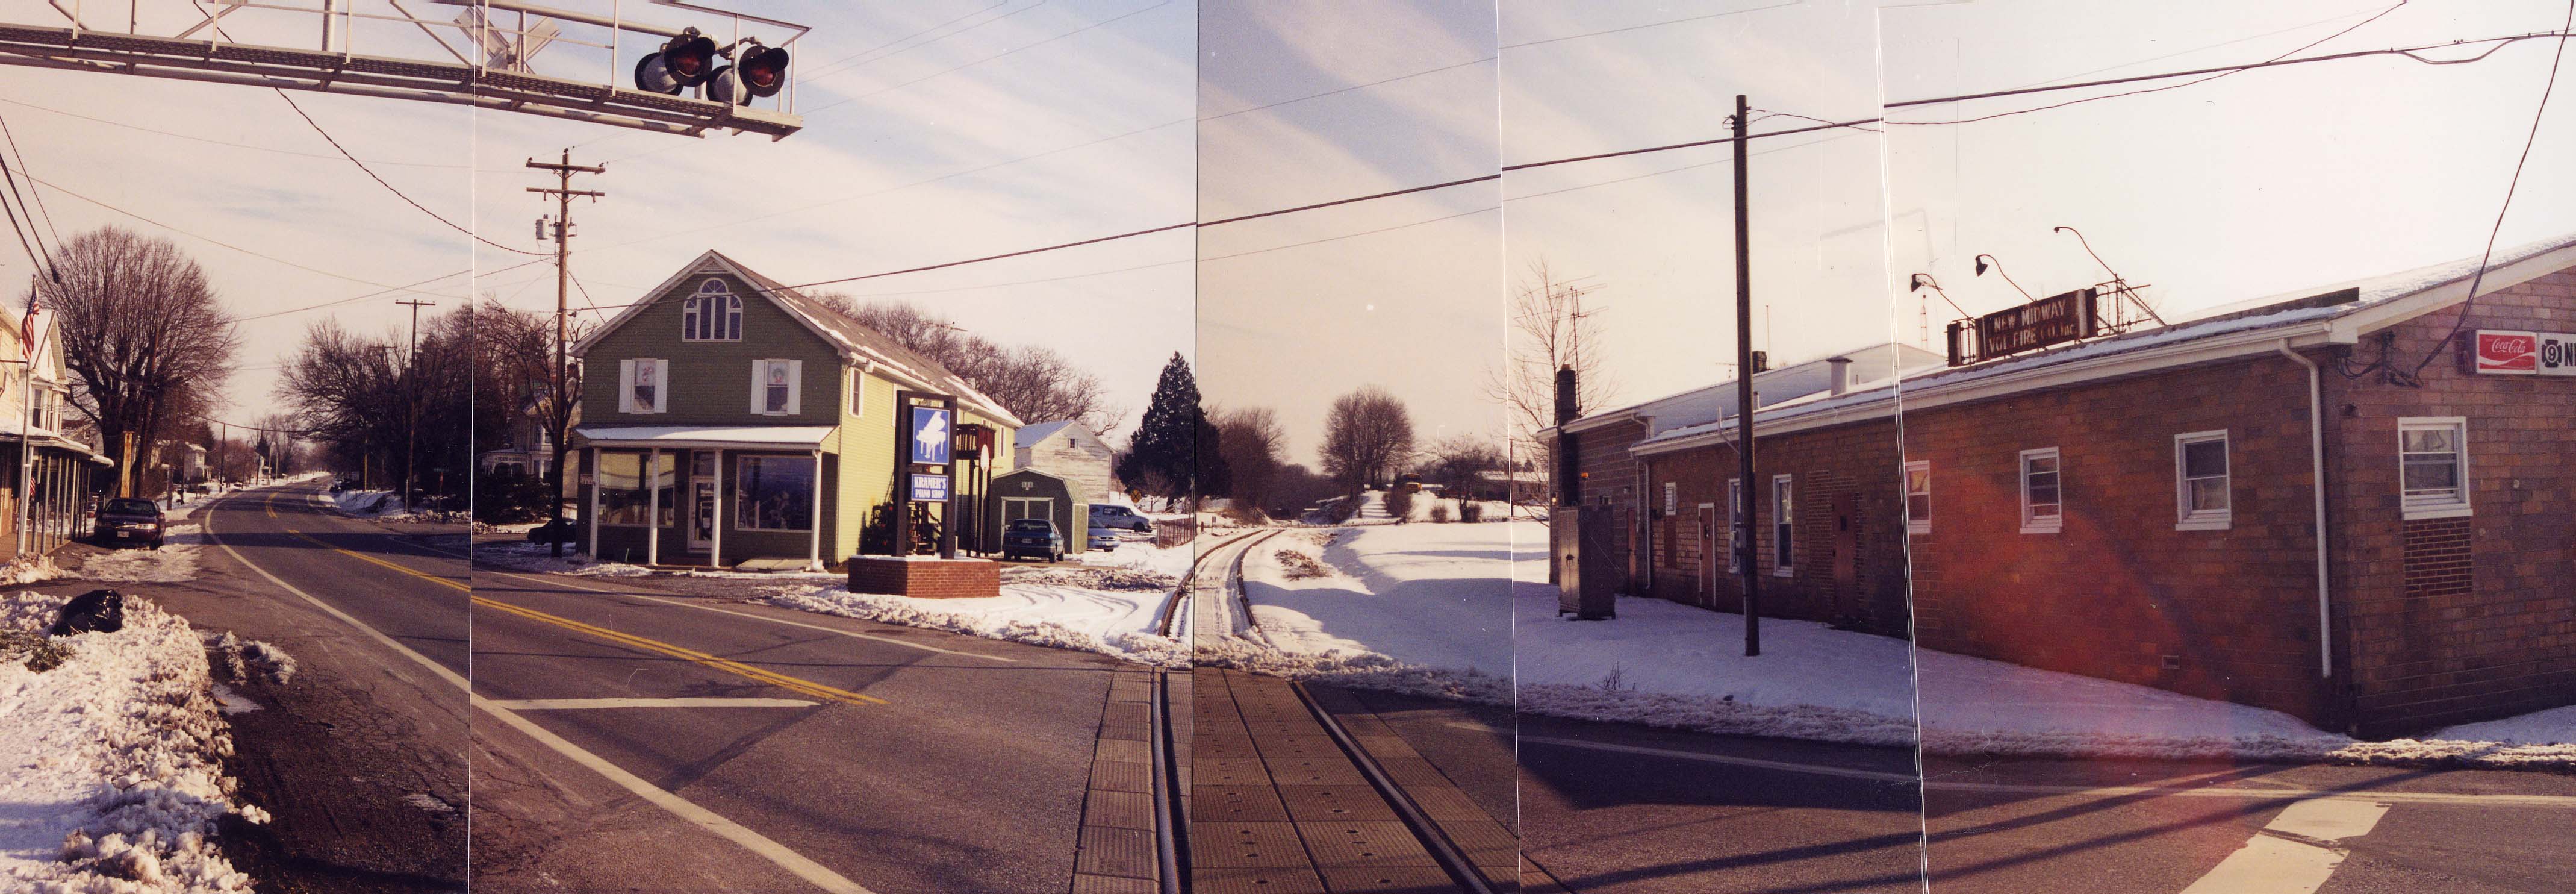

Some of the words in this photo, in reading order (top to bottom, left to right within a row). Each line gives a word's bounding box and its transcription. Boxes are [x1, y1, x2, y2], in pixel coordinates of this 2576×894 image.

[1994, 314, 2015, 331] NEW
[2021, 300, 2065, 326] MIDWAY
[2013, 328, 2037, 348] FIRE
[2548, 346, 2557, 361] 9
[2565, 342, 2576, 366] N
[914, 477, 946, 489] KRAMER'S
[915, 489, 930, 498] PIANO
[932, 490, 945, 499] SHOP
